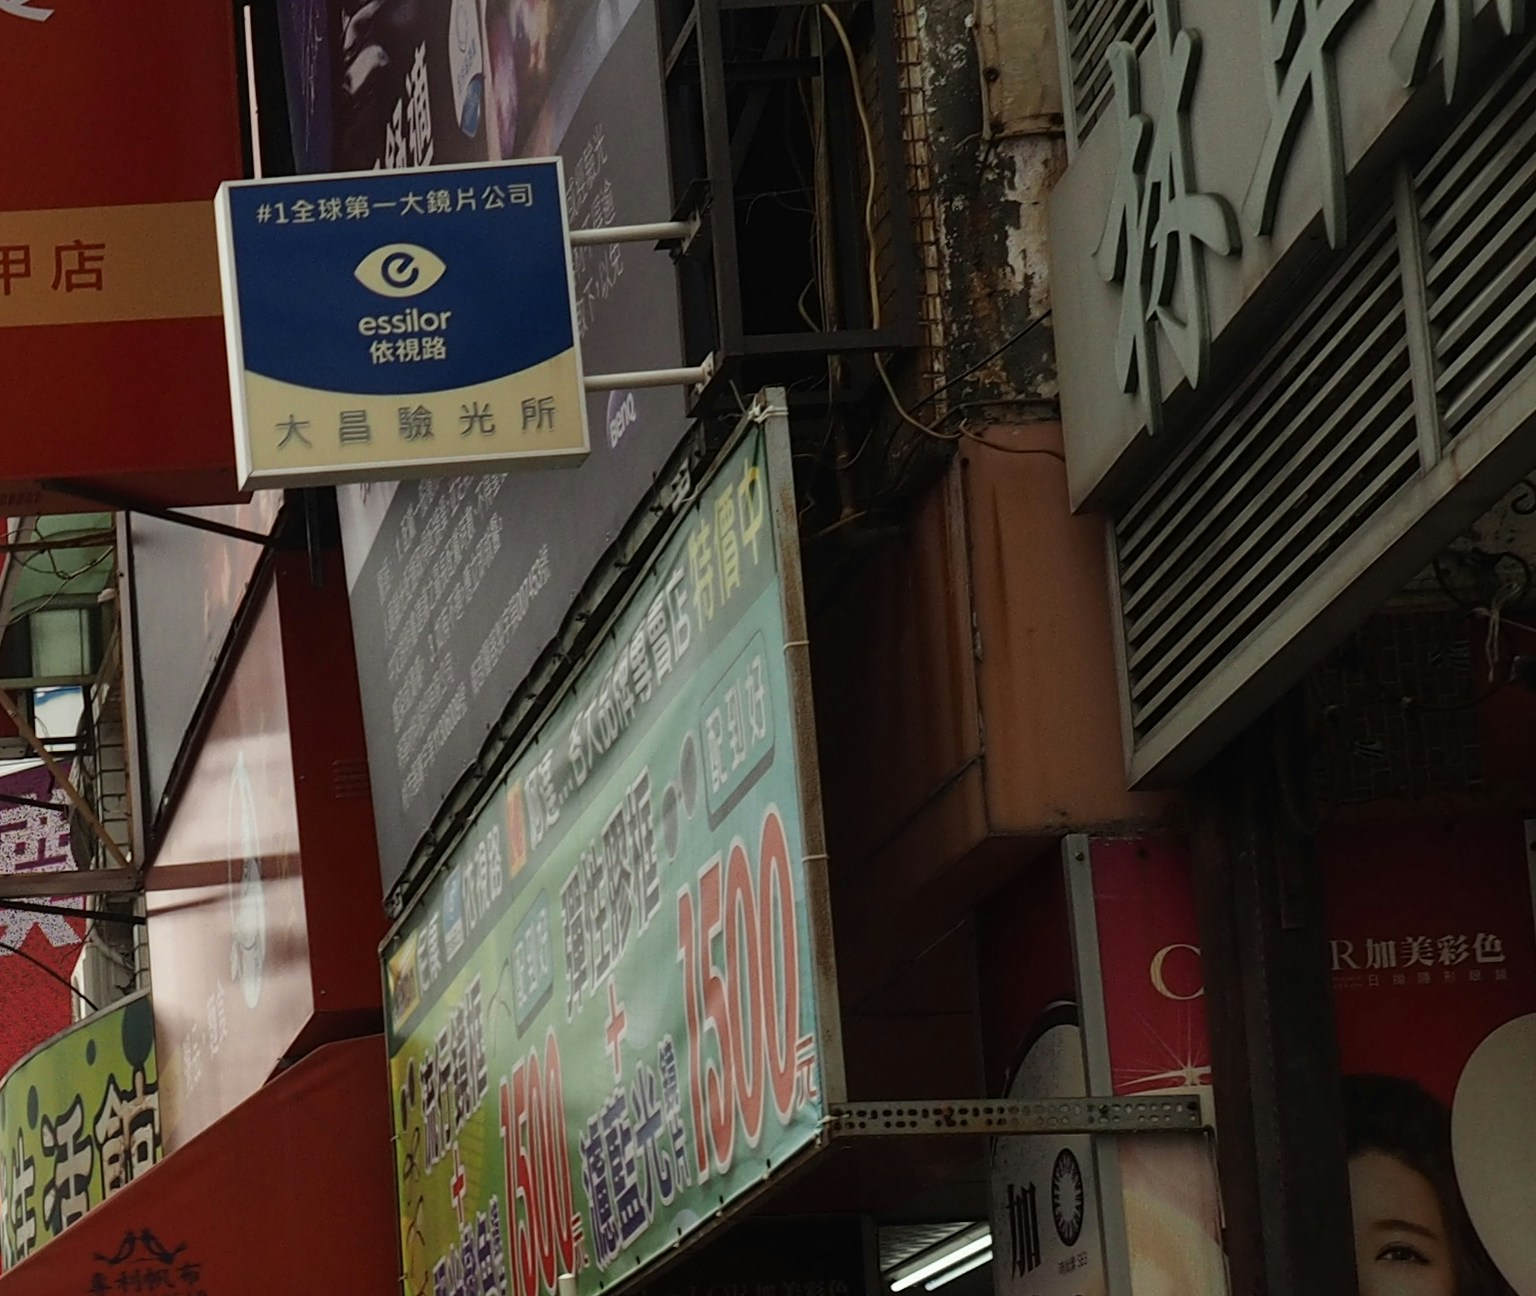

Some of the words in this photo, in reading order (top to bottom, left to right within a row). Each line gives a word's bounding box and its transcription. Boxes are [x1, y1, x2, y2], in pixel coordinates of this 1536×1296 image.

[256, 183, 533, 225] #1全球第一大鏡片公司
[359, 308, 452, 336] essilor
[369, 336, 447, 365] 依視路
[275, 395, 557, 449] 大昌驗光所
[1364, 932, 1507, 969] 加美彩色
[676, 803, 801, 1187] 1500
